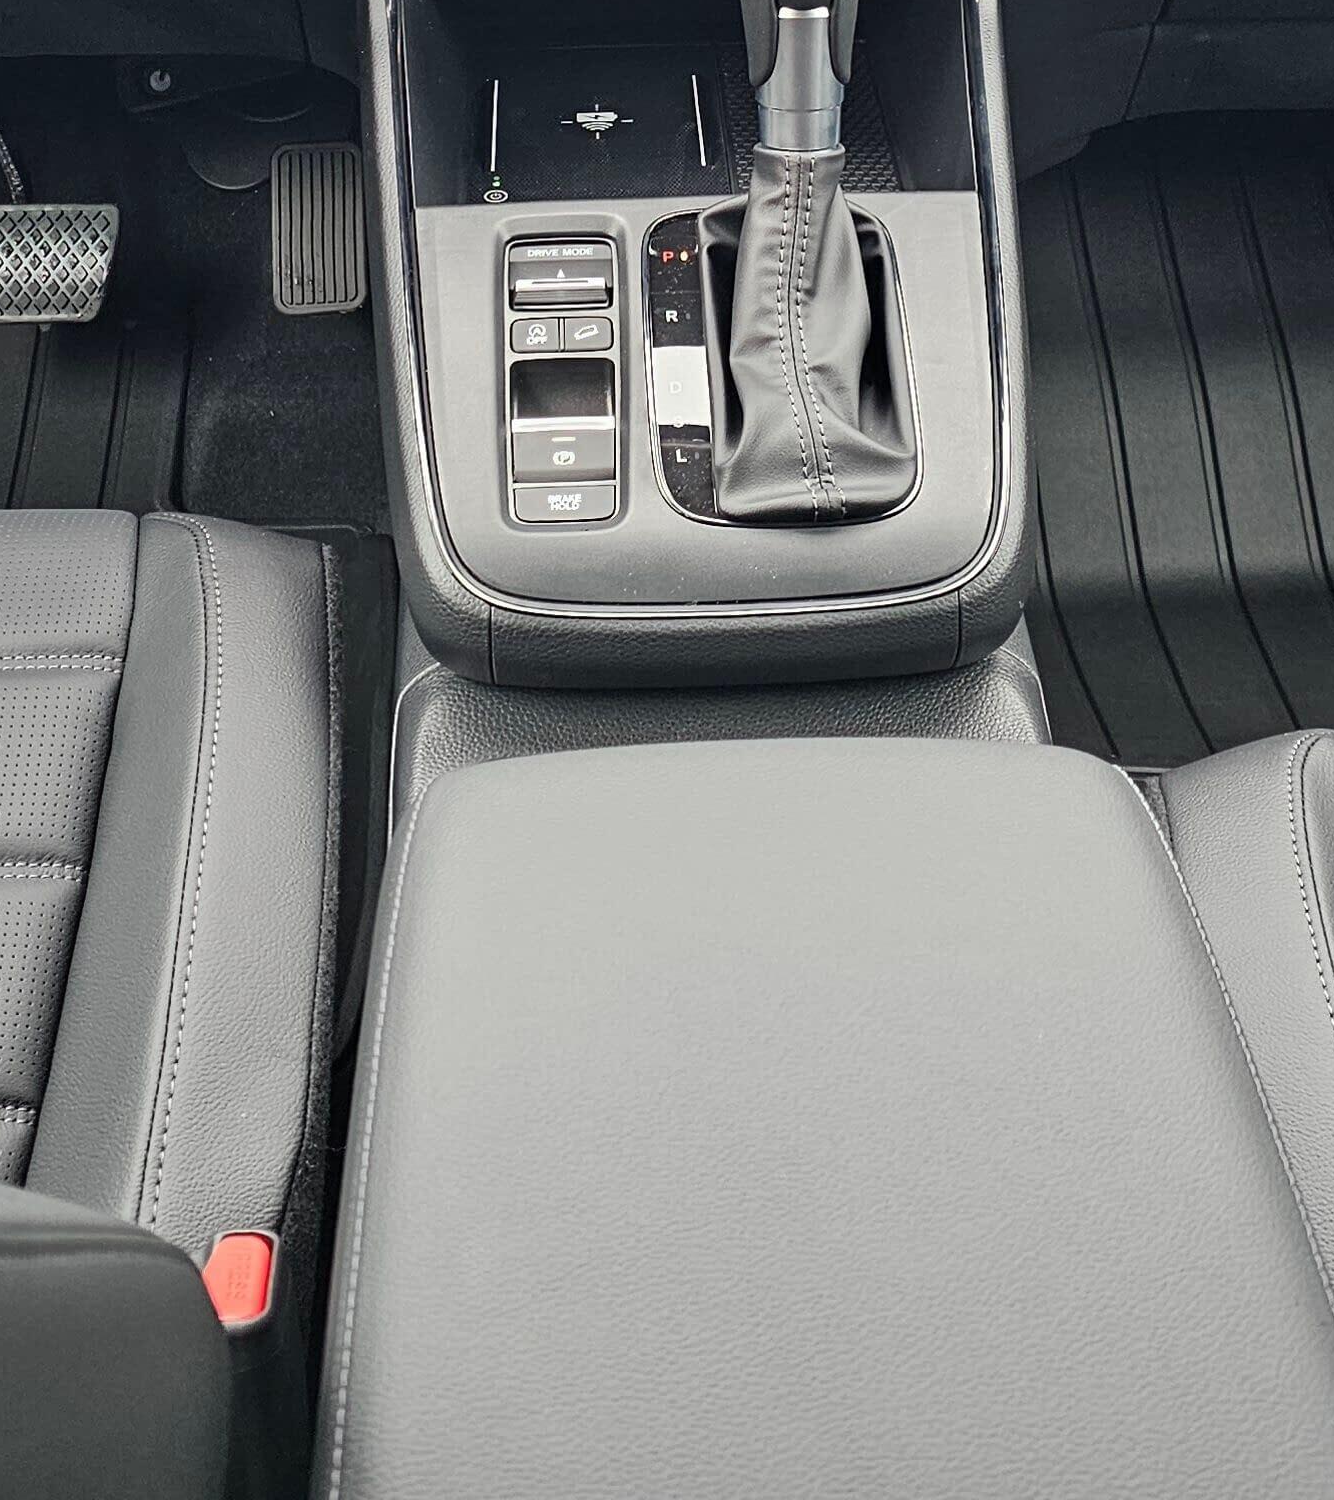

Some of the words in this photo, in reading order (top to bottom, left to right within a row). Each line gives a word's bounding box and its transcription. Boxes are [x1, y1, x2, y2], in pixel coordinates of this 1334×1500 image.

[527, 248, 559, 258] DRIVE
[562, 247, 594, 257] MODE
[662, 250, 674, 263] P
[665, 310, 679, 323] R
[526, 335, 549, 346] OFF
[669, 381, 683, 395] D
[675, 448, 688, 463] L
[547, 493, 582, 503] BRAKE
[550, 501, 580, 511] HOLD
